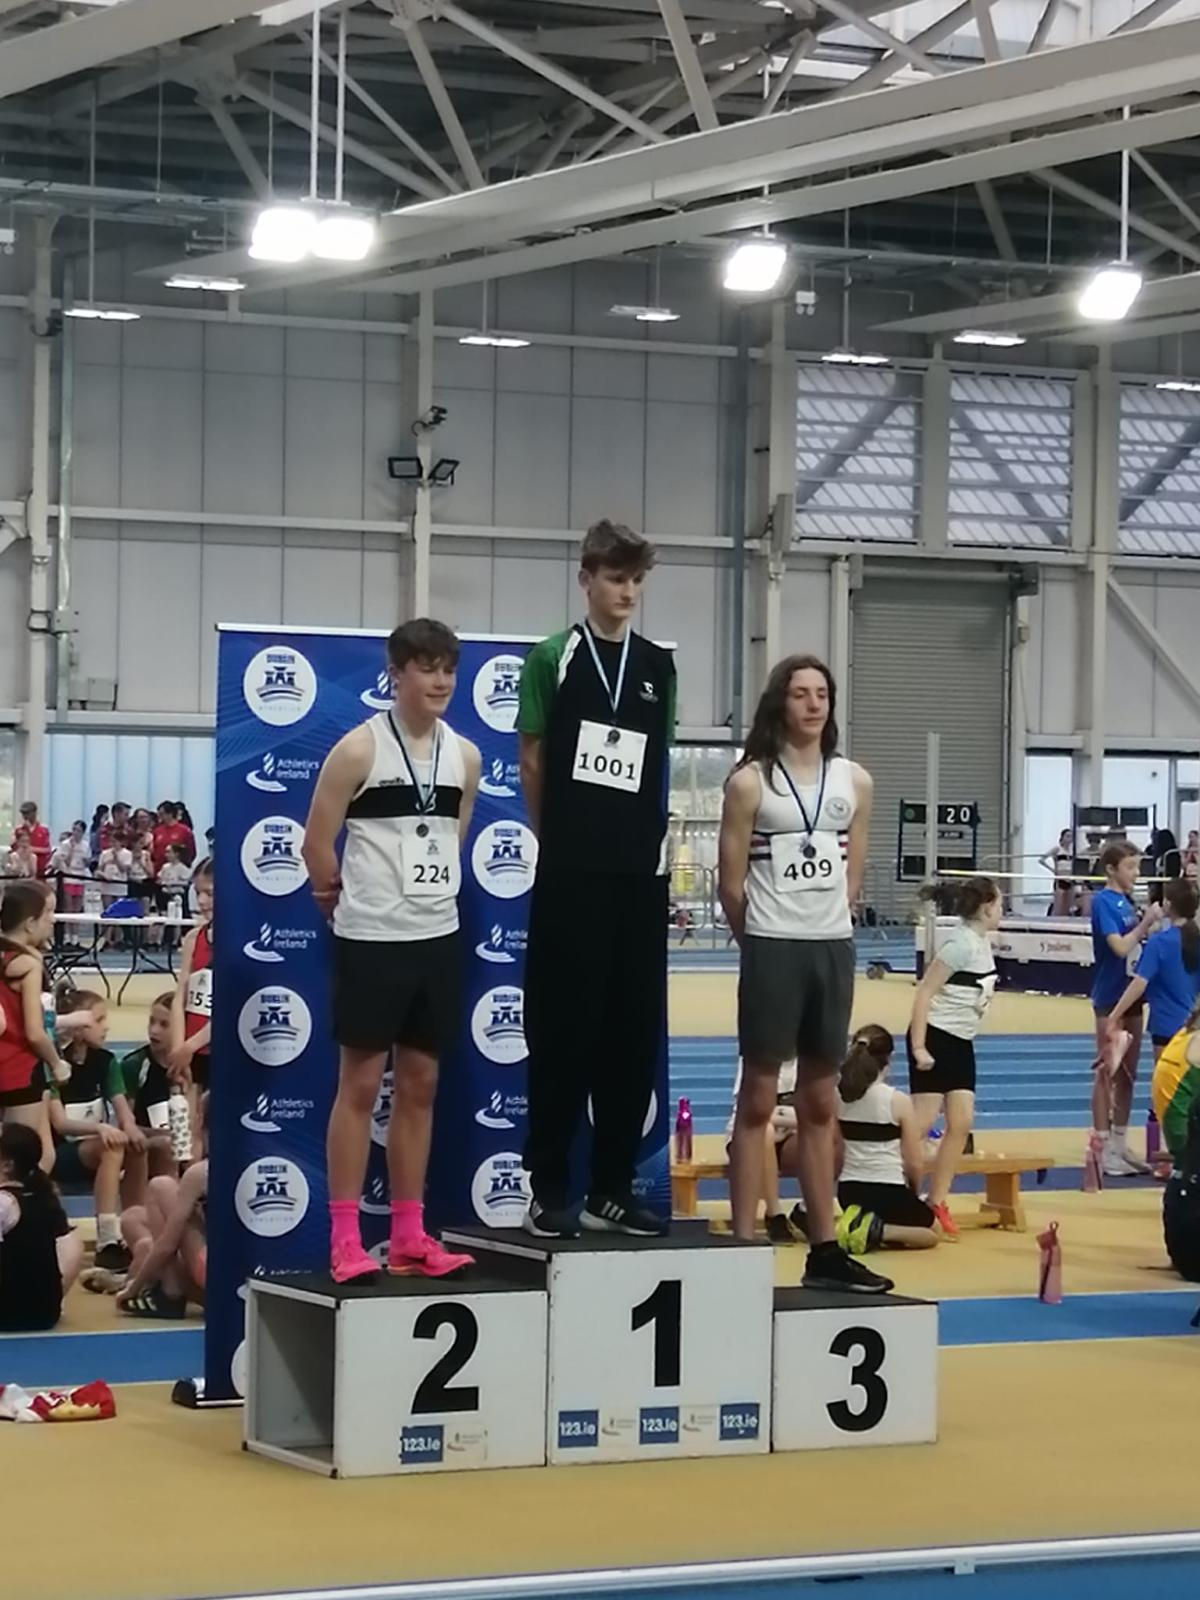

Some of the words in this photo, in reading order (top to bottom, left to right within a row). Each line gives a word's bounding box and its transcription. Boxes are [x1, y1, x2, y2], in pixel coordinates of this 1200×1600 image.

[276, 757, 320, 770] Athletics
[578, 752, 636, 781] 1001
[276, 769, 310, 780] Ireland
[946, 807, 971, 824] 20
[413, 864, 451, 885] 224
[783, 858, 832, 881] 409
[273, 928, 317, 940] Athletics
[273, 938, 307, 949] Ireland
[271, 1097, 315, 1109] Athletics
[271, 1108, 305, 1120] Ireland
[632, 1280, 682, 1387] 1
[411, 1302, 479, 1414] 2
[826, 1326, 888, 1432] 3
[559, 1421, 597, 1436] 123.ie
[641, 1417, 678, 1433] 123.ie
[722, 1412, 758, 1429] 123.ie
[402, 1437, 442, 1452] 123.ie
